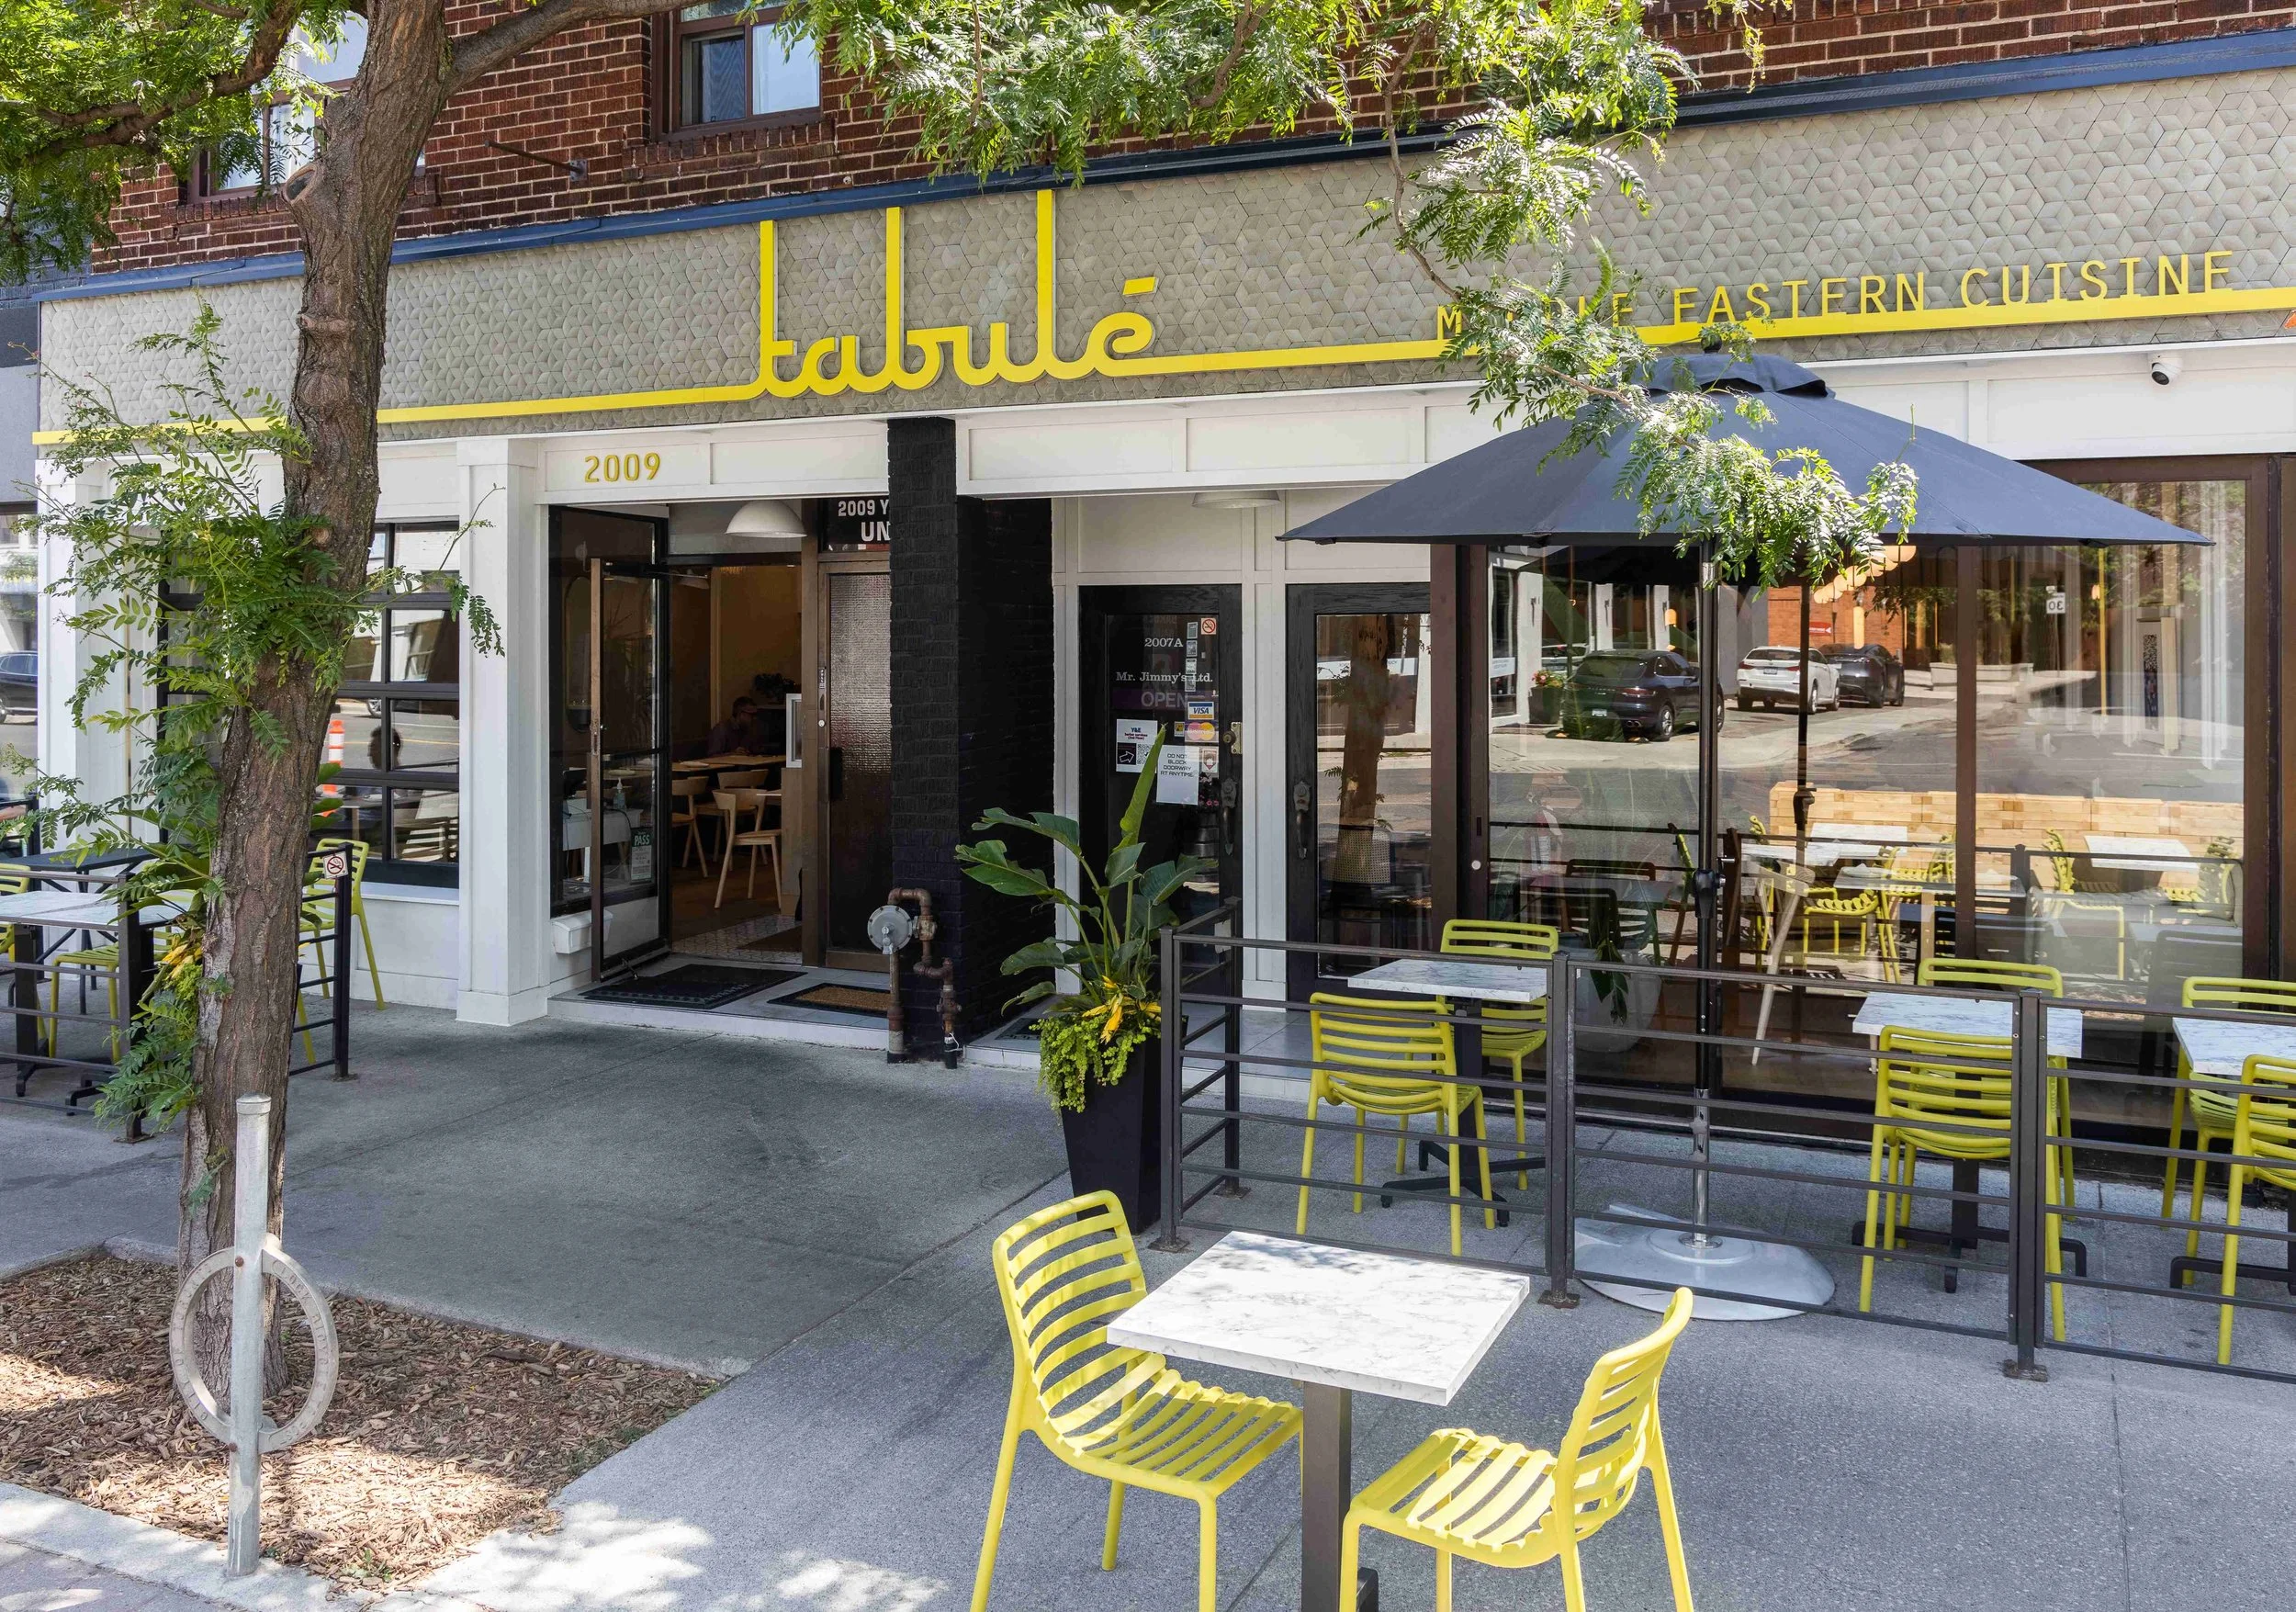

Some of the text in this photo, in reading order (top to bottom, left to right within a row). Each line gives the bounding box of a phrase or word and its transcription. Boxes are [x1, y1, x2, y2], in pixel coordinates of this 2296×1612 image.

[755, 189, 1159, 399] tabulé
[1674, 271, 1924, 325] EASTERN
[1960, 250, 2234, 308] CUISINE
[584, 452, 661, 483] 2009
[838, 499, 876, 517] 2009
[1143, 637, 1184, 648] 2007A
[1116, 671, 1136, 682] Mr.
[1139, 671, 1187, 684] Jimmy's
[1141, 691, 1188, 708] OPEN
[634, 834, 650, 845] PASS
